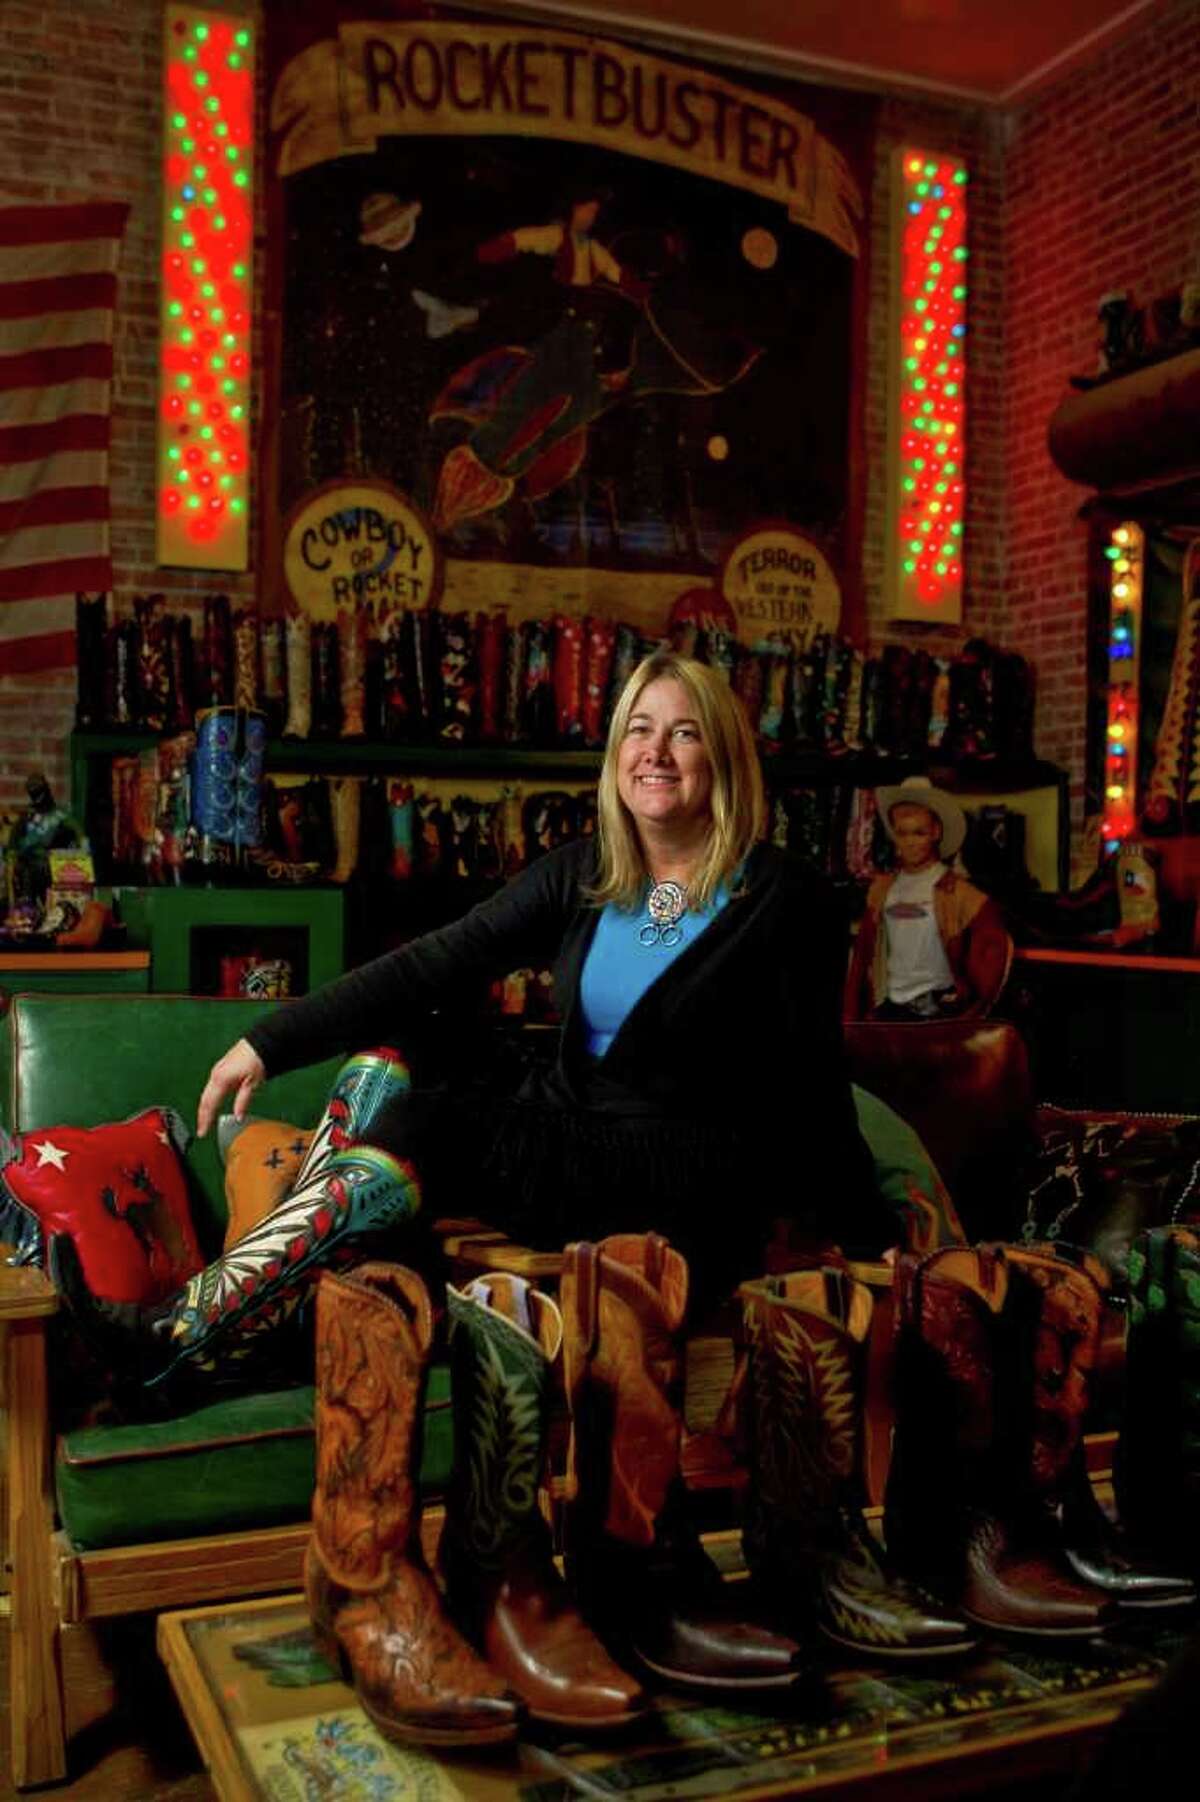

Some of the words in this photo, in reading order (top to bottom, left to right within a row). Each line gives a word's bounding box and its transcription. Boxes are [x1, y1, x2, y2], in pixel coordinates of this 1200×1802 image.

[363, 38, 799, 188] ROCKETBUSTER
[301, 506, 423, 572] COWBOY
[352, 546, 374, 569] OR
[737, 548, 816, 584] TERROR
[331, 572, 423, 605] ROCKET
